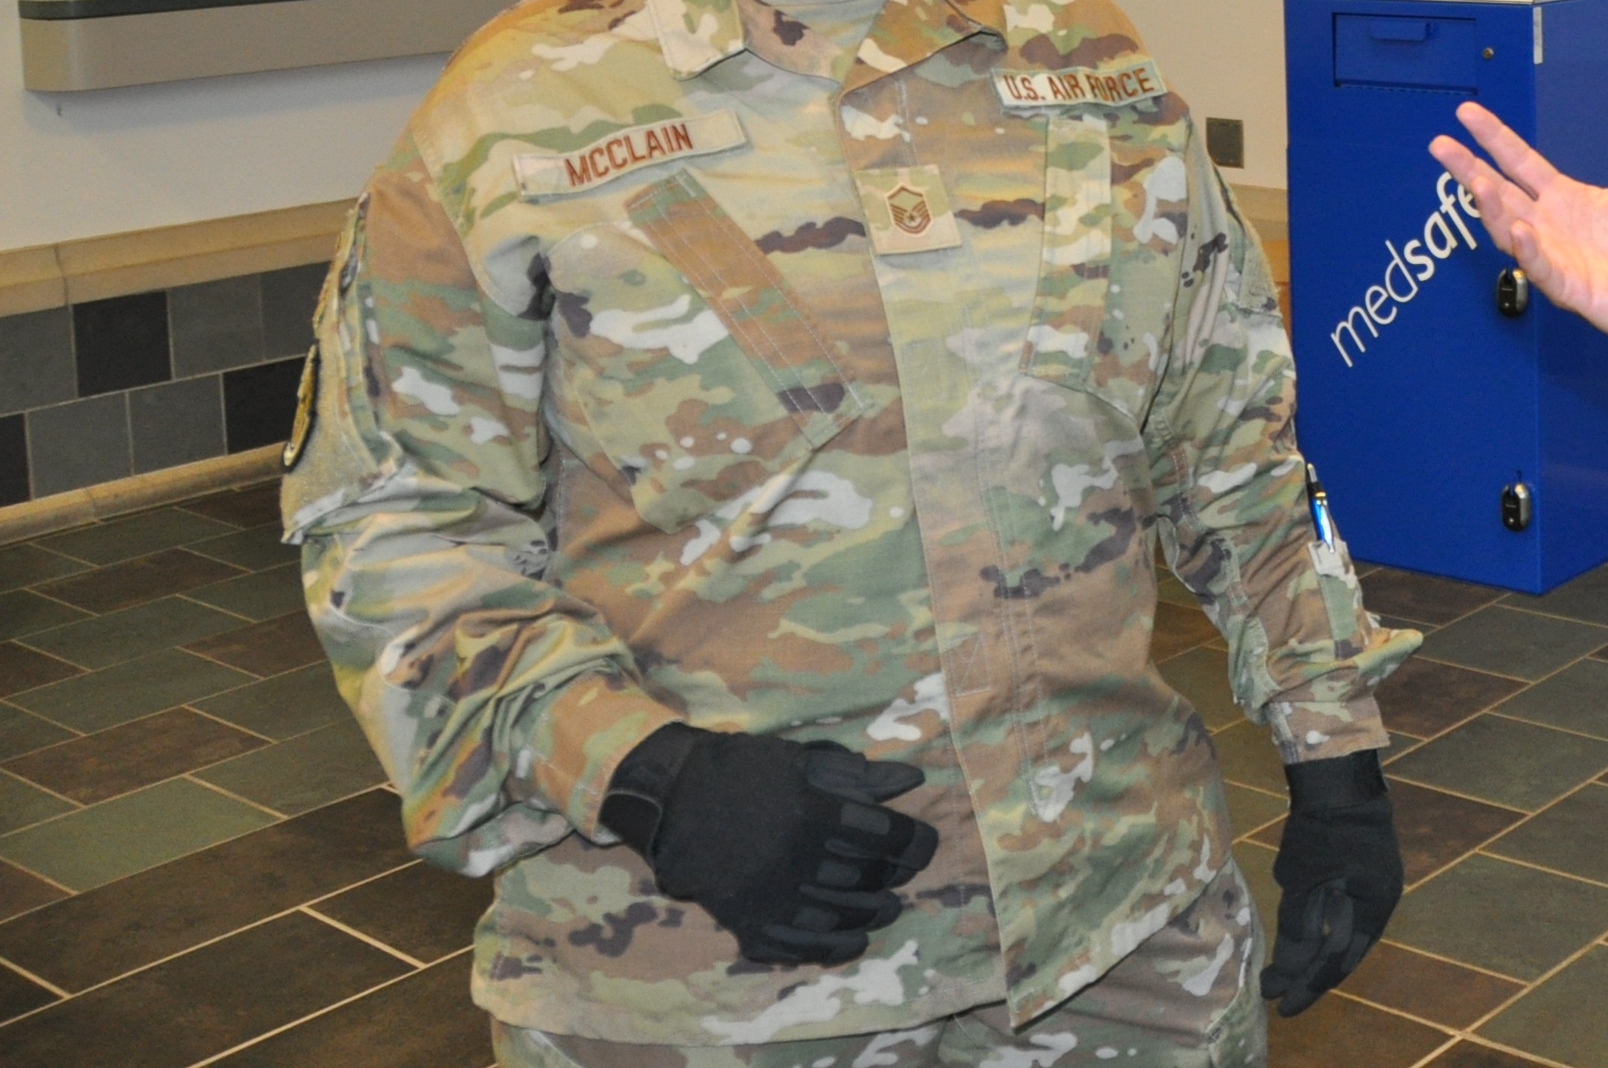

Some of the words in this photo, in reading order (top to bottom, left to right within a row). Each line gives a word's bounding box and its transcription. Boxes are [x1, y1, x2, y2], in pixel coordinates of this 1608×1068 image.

[1003, 74, 1046, 101] U.S.
[1047, 73, 1086, 100] AIR
[1084, 67, 1154, 102] FORCE
[564, 123, 694, 187] MCCLAIN
